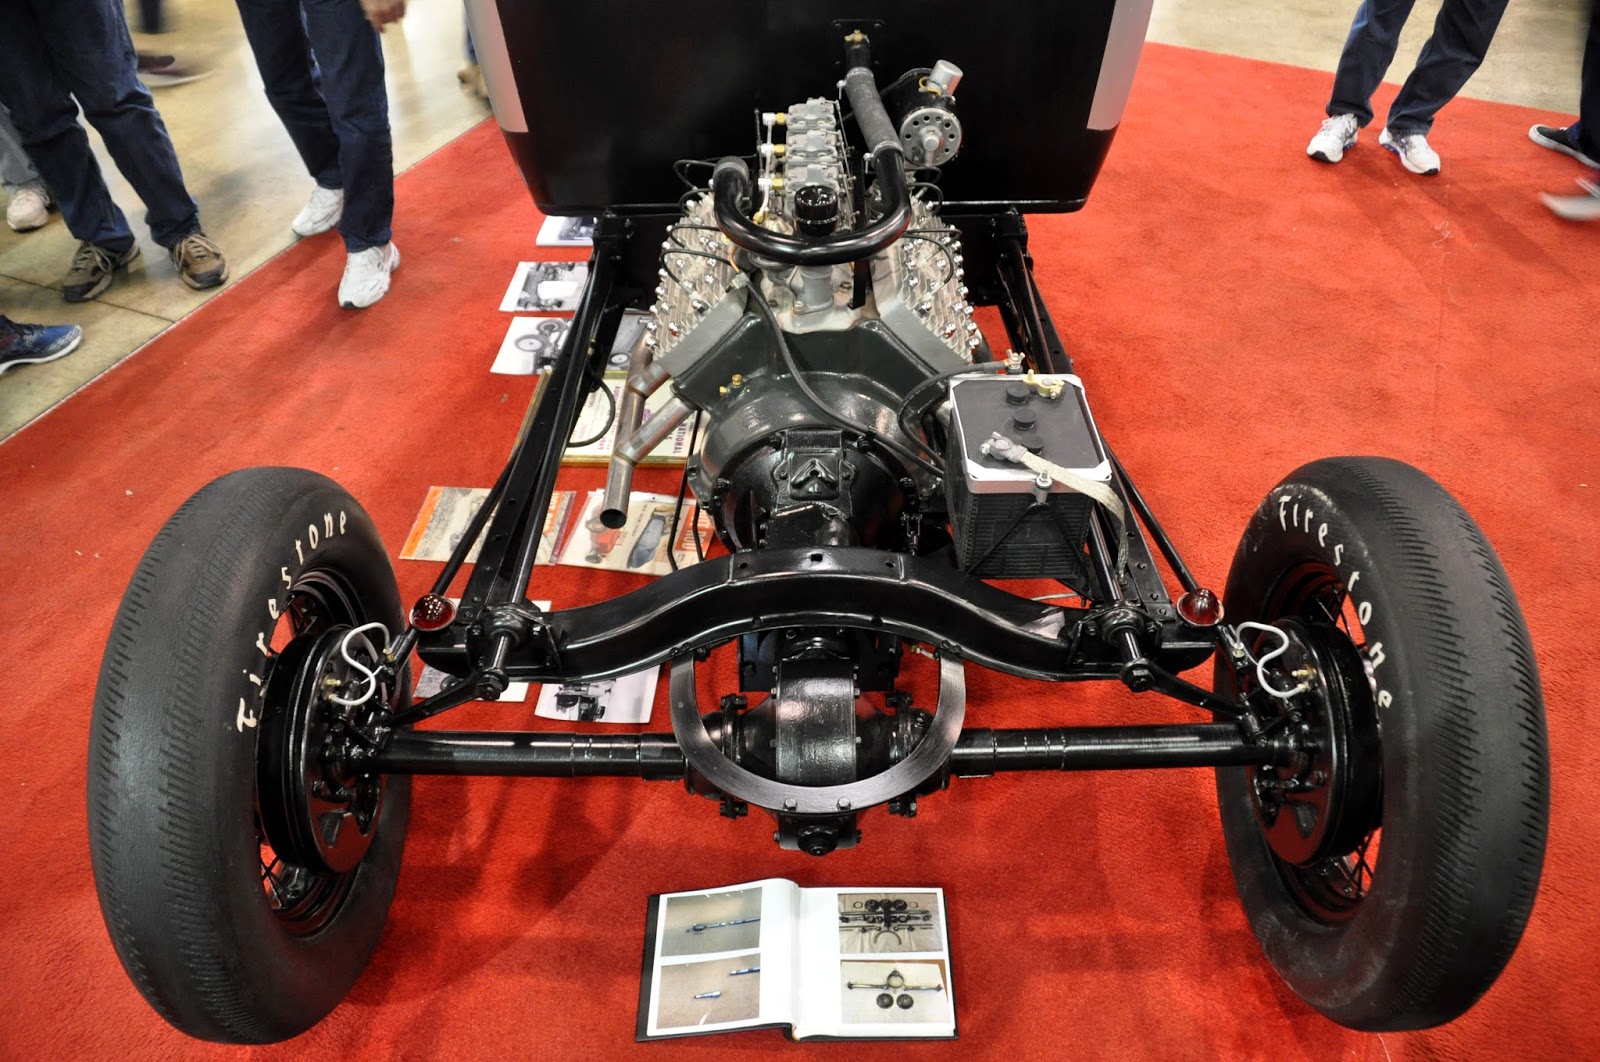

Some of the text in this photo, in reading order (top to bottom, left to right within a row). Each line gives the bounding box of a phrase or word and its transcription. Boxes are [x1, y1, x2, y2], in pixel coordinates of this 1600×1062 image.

[673, 423, 688, 454] NATIONAL
[236, 510, 347, 733] Firestone
[1279, 494, 1392, 709] Firestone
